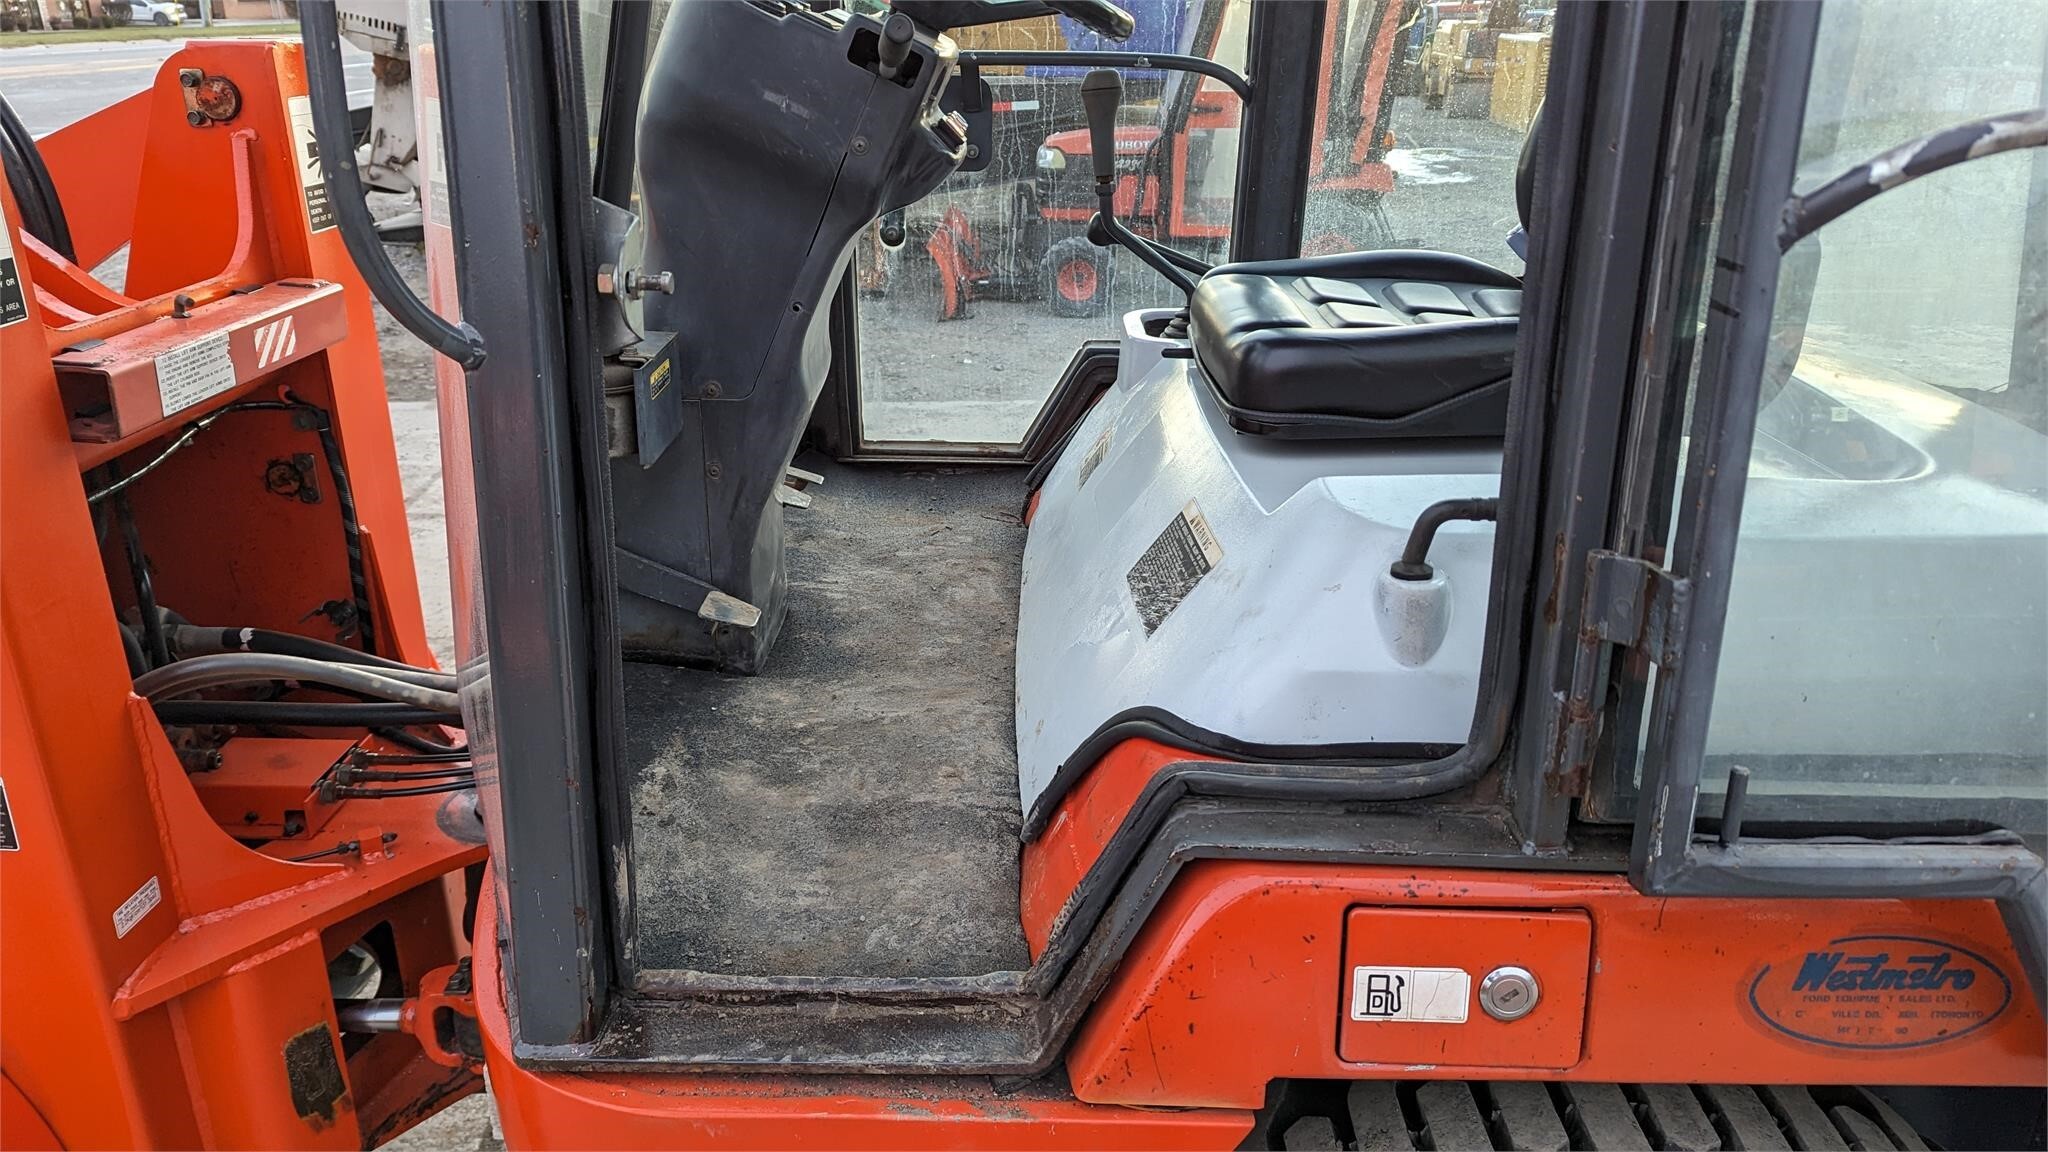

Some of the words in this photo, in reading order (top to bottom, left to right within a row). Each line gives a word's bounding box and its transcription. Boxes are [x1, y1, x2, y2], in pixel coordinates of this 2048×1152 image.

[1115, 140, 1152, 150] UBOT
[5, 278, 16, 287] OR
[6, 301, 20, 313] AREA
[1791, 951, 1976, 992] Westmetro
[1372, 995, 1384, 1008] D
